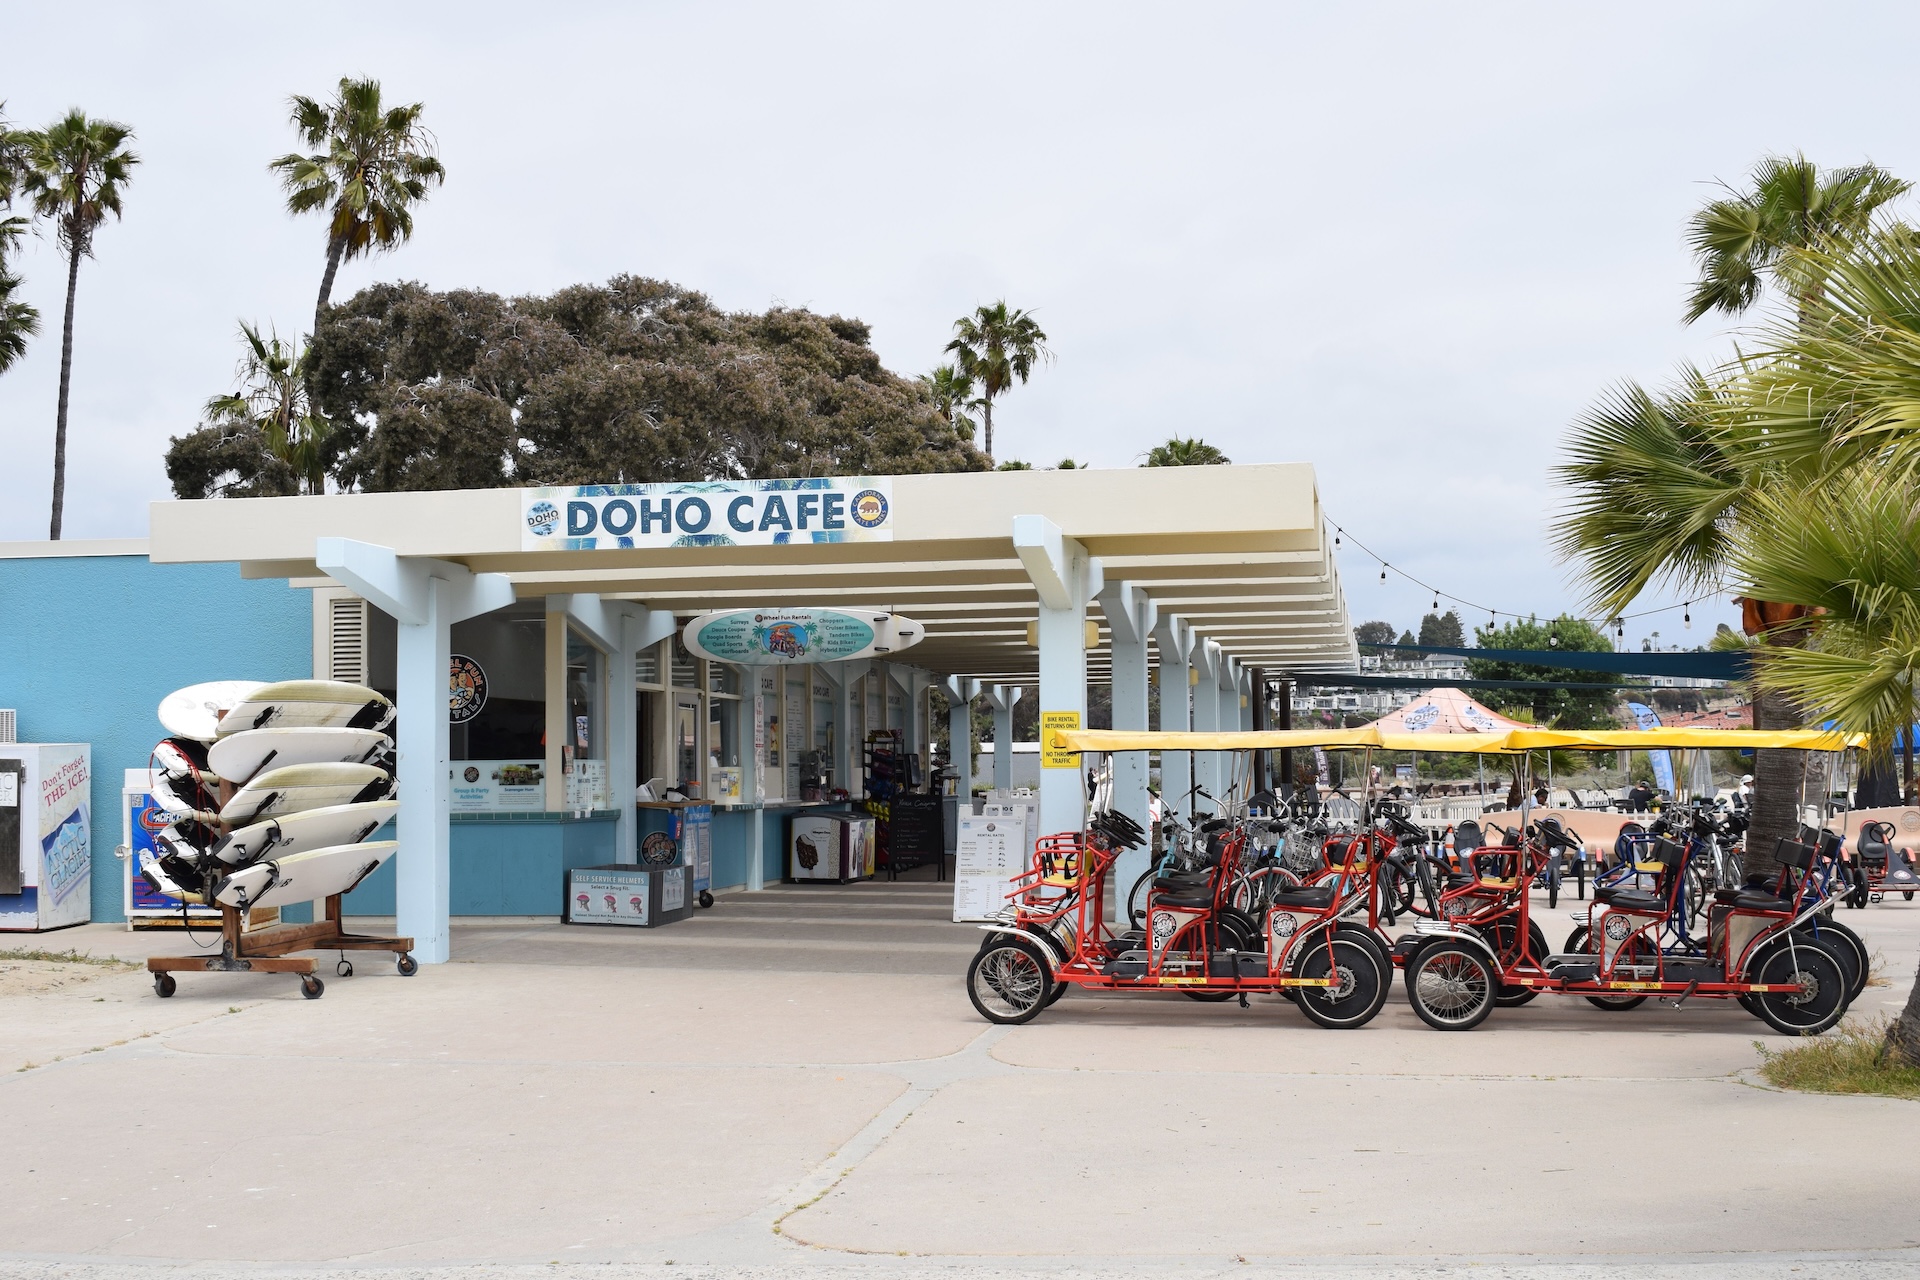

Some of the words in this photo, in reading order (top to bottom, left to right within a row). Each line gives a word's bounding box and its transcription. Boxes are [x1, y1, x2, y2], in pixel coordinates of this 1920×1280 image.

[852, 491, 886, 507] CALIFORNIA
[528, 510, 558, 526] DOHO
[567, 497, 712, 536] DOHO
[727, 493, 844, 532] CAFE
[852, 510, 868, 526] STATE
[872, 510, 886, 526] PARKS
[464, 662, 483, 686] FUN
[1405, 710, 1439, 724] DOHO
[42, 770, 63, 791] Don't
[61, 755, 85, 777] Forget
[44, 784, 67, 807] THE
[68, 767, 89, 791] ICE!
[153, 812, 177, 823] PACIFIC
[47, 825, 87, 876] ARCTIC
[50, 847, 92, 890] GLACIER
[1154, 937, 1160, 948] 5
